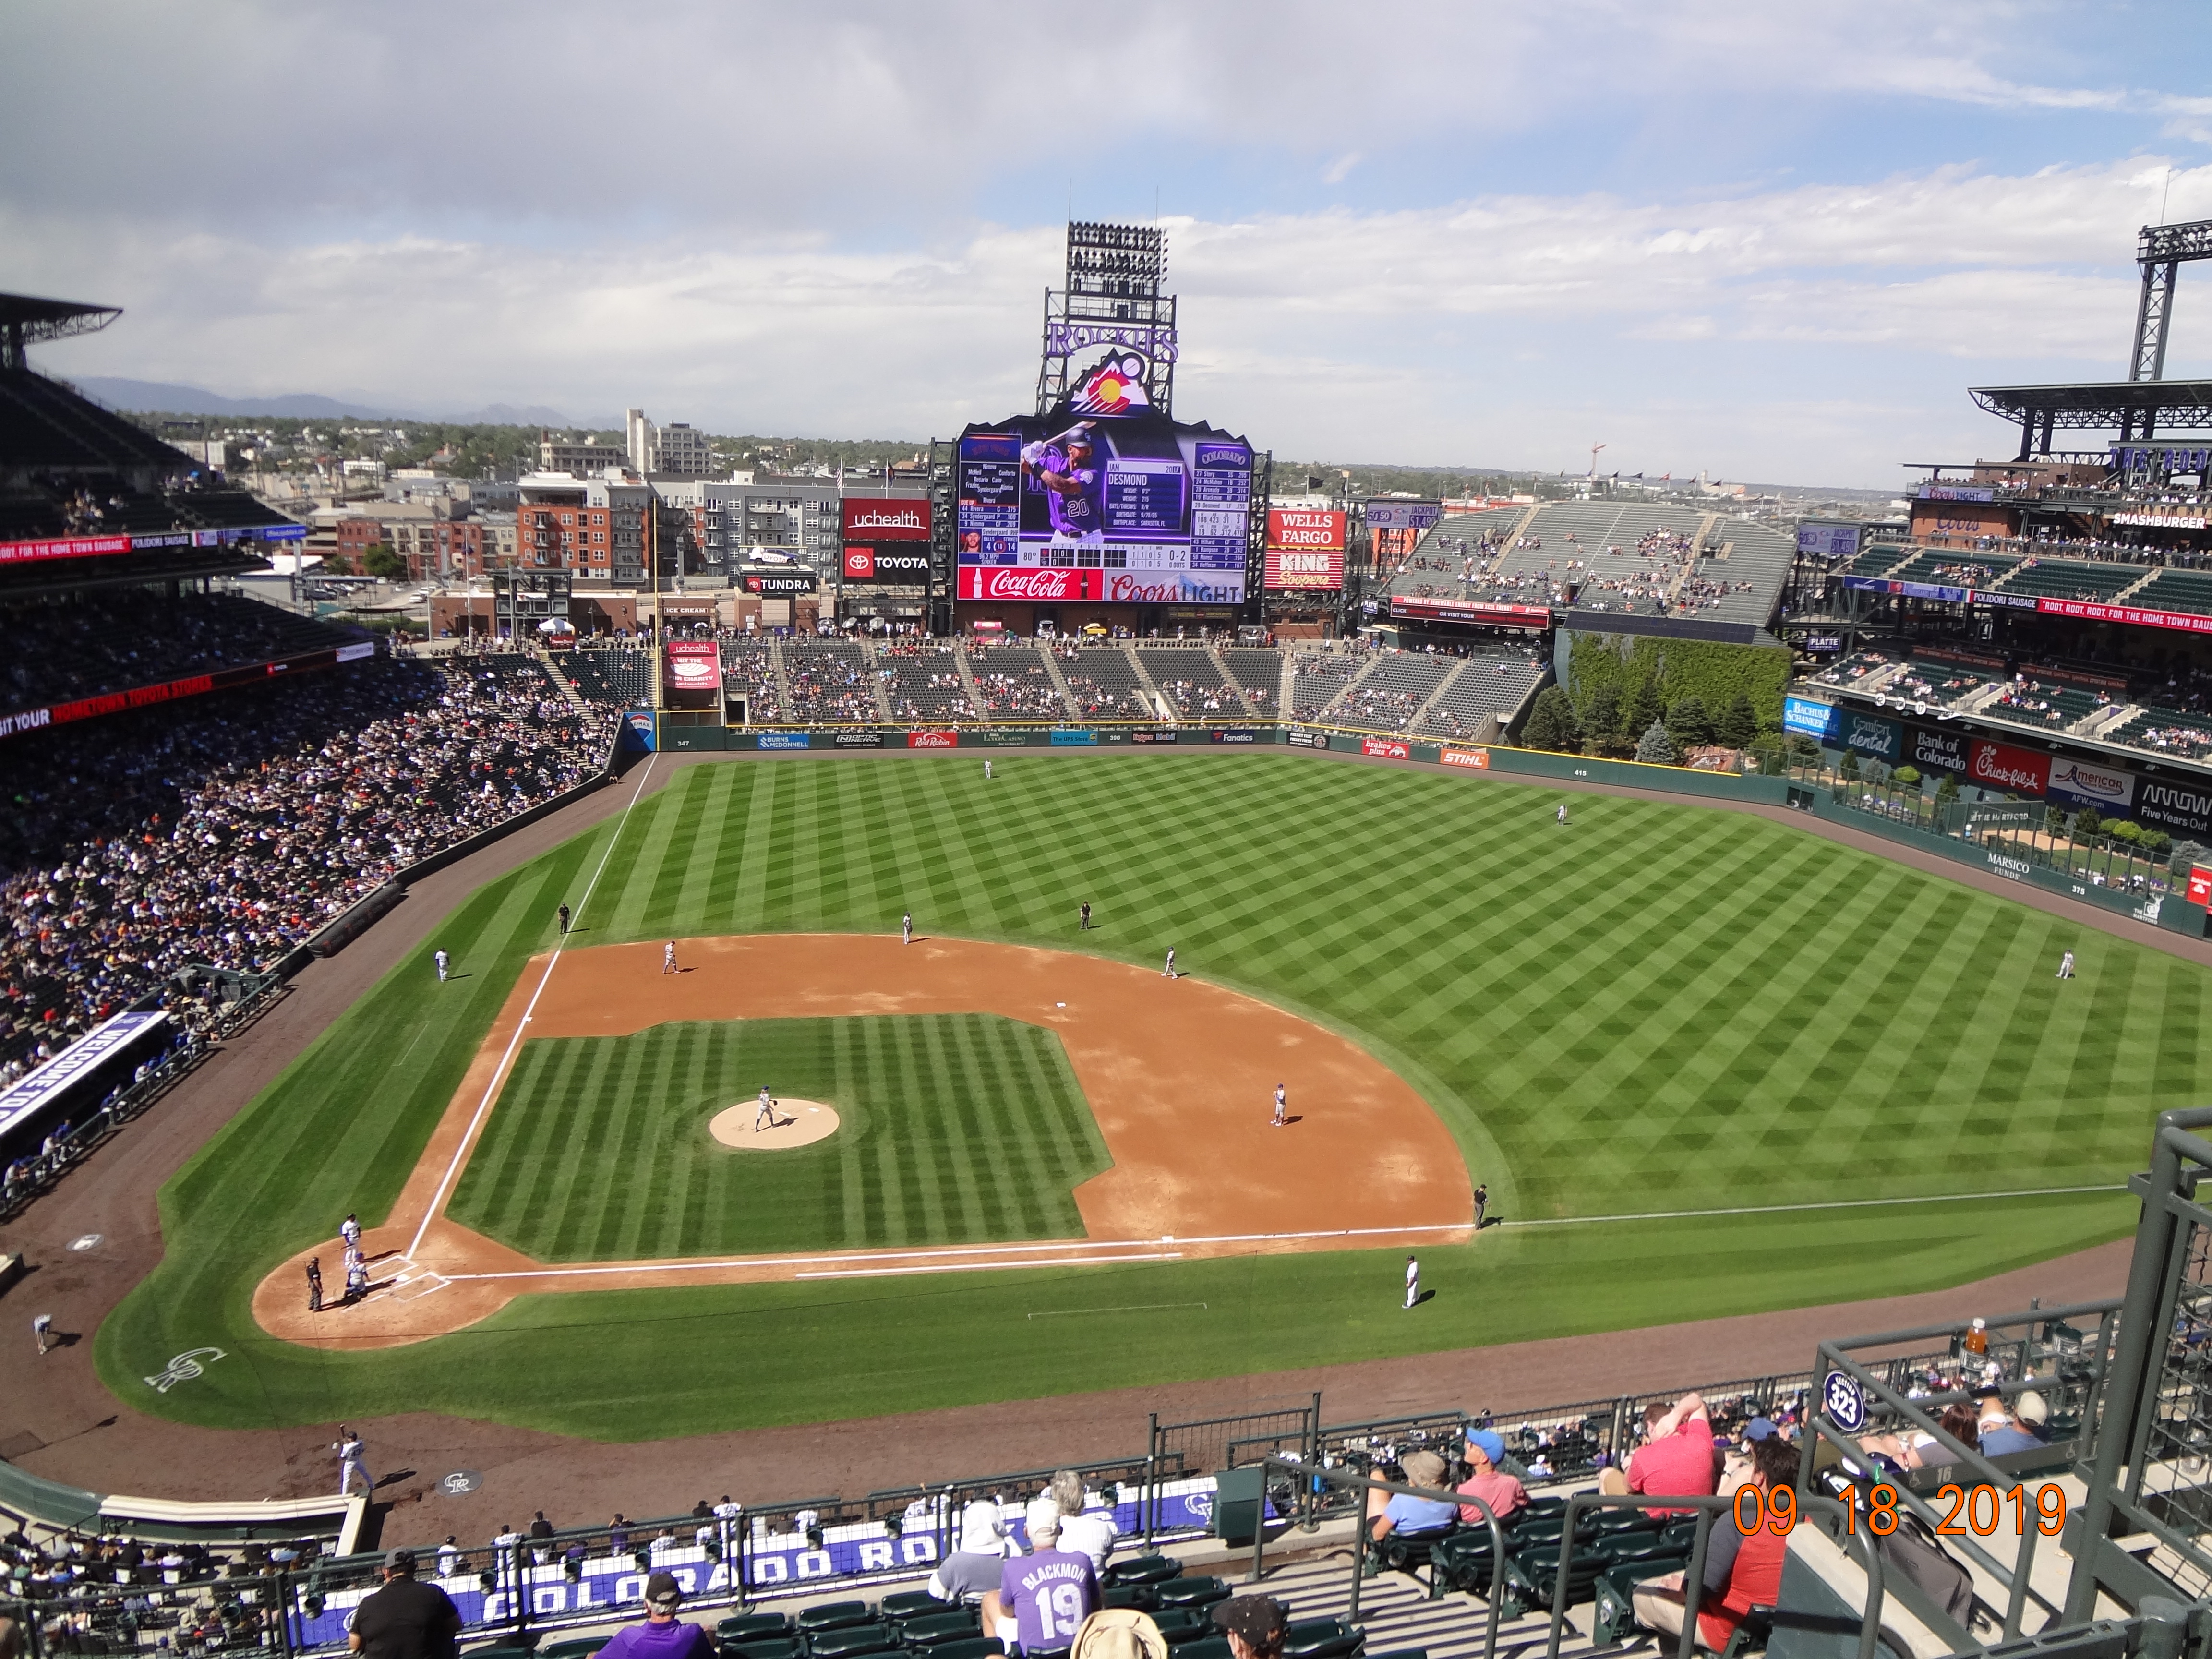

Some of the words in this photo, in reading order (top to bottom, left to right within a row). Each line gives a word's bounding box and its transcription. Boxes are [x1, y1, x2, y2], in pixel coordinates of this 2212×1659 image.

[1046, 324, 1178, 363] ROCKIES
[1201, 450, 1246, 465] COLORADO
[2110, 447, 2148, 469] THE
[1108, 474, 1147, 486] DESMOND
[1929, 486, 1955, 500] Coors
[1956, 491, 1980, 501] LIGHT
[1067, 498, 1089, 517] 20
[1411, 506, 1436, 515] JACKPOT
[855, 510, 919, 528] uchealth
[1281, 514, 1333, 528] WELLS
[2114, 513, 2205, 529] SMASHBURGER
[1281, 530, 1333, 545] FARGO
[19, 547, 33, 558] FOR
[36, 545, 49, 556] THE
[51, 543, 71, 556] HOME
[72, 541, 93, 553] TOWN
[874, 557, 929, 570] TOYOTA
[1279, 554, 1330, 572] KING
[760, 579, 811, 590] TUNDRA
[990, 569, 1071, 597] Coca-Cola
[1277, 570, 1330, 588] Soopers
[1111, 575, 1178, 601] Coors
[1181, 585, 1239, 602] LIGHT
[1974, 593, 2006, 604] POLIDORI
[2008, 597, 2037, 608] SAUSAGE
[2066, 603, 2084, 615] ROOT,
[2087, 607, 2106, 618] ROOT,
[2109, 609, 2123, 619] FOR
[2126, 611, 2140, 622] THE
[2142, 613, 2164, 624] HOME
[2167, 616, 2190, 627] TOWN
[676, 644, 709, 652] uchealth
[14, 708, 50, 730] YOUR
[53, 694, 125, 719] HOMETOWN
[128, 685, 169, 705] TOYOTA
[172, 675, 213, 697] STORES
[1793, 702, 1823, 718] BACHUS
[1823, 709, 1830, 720] &
[1918, 704, 1924, 713] 17
[1786, 710, 1824, 729] SCHANKER
[915, 737, 928, 746] Red
[929, 738, 950, 746] Robin
[1133, 733, 1154, 742] Exxon
[1365, 740, 1392, 749] brakes
[1849, 728, 1892, 754] dental
[1918, 732, 1945, 750] Bank
[1947, 738, 1959, 753] of
[1444, 752, 1483, 766] STIHL
[1916, 746, 1966, 771] Colorado
[1976, 750, 2038, 790] Chick-fil-A
[2071, 794, 2104, 809] AFW.com
[2141, 805, 2161, 820] Five
[2162, 811, 2188, 827] Years
[2190, 817, 2208, 832] Out
[1987, 853, 2030, 874] MARSICO
[1995, 866, 2020, 880] FUNDS
[2072, 885, 2085, 895] 375
[2133, 913, 2158, 925] HARTFORD
[26, 1029, 129, 1088] WELCOME
[0, 1089, 43, 1107] TO
[1829, 1383, 1857, 1424] 323
[1936, 1467, 1952, 1483] 16
[1022, 1563, 1086, 1591] BLACKMON
[1035, 1583, 1084, 1640] 19
